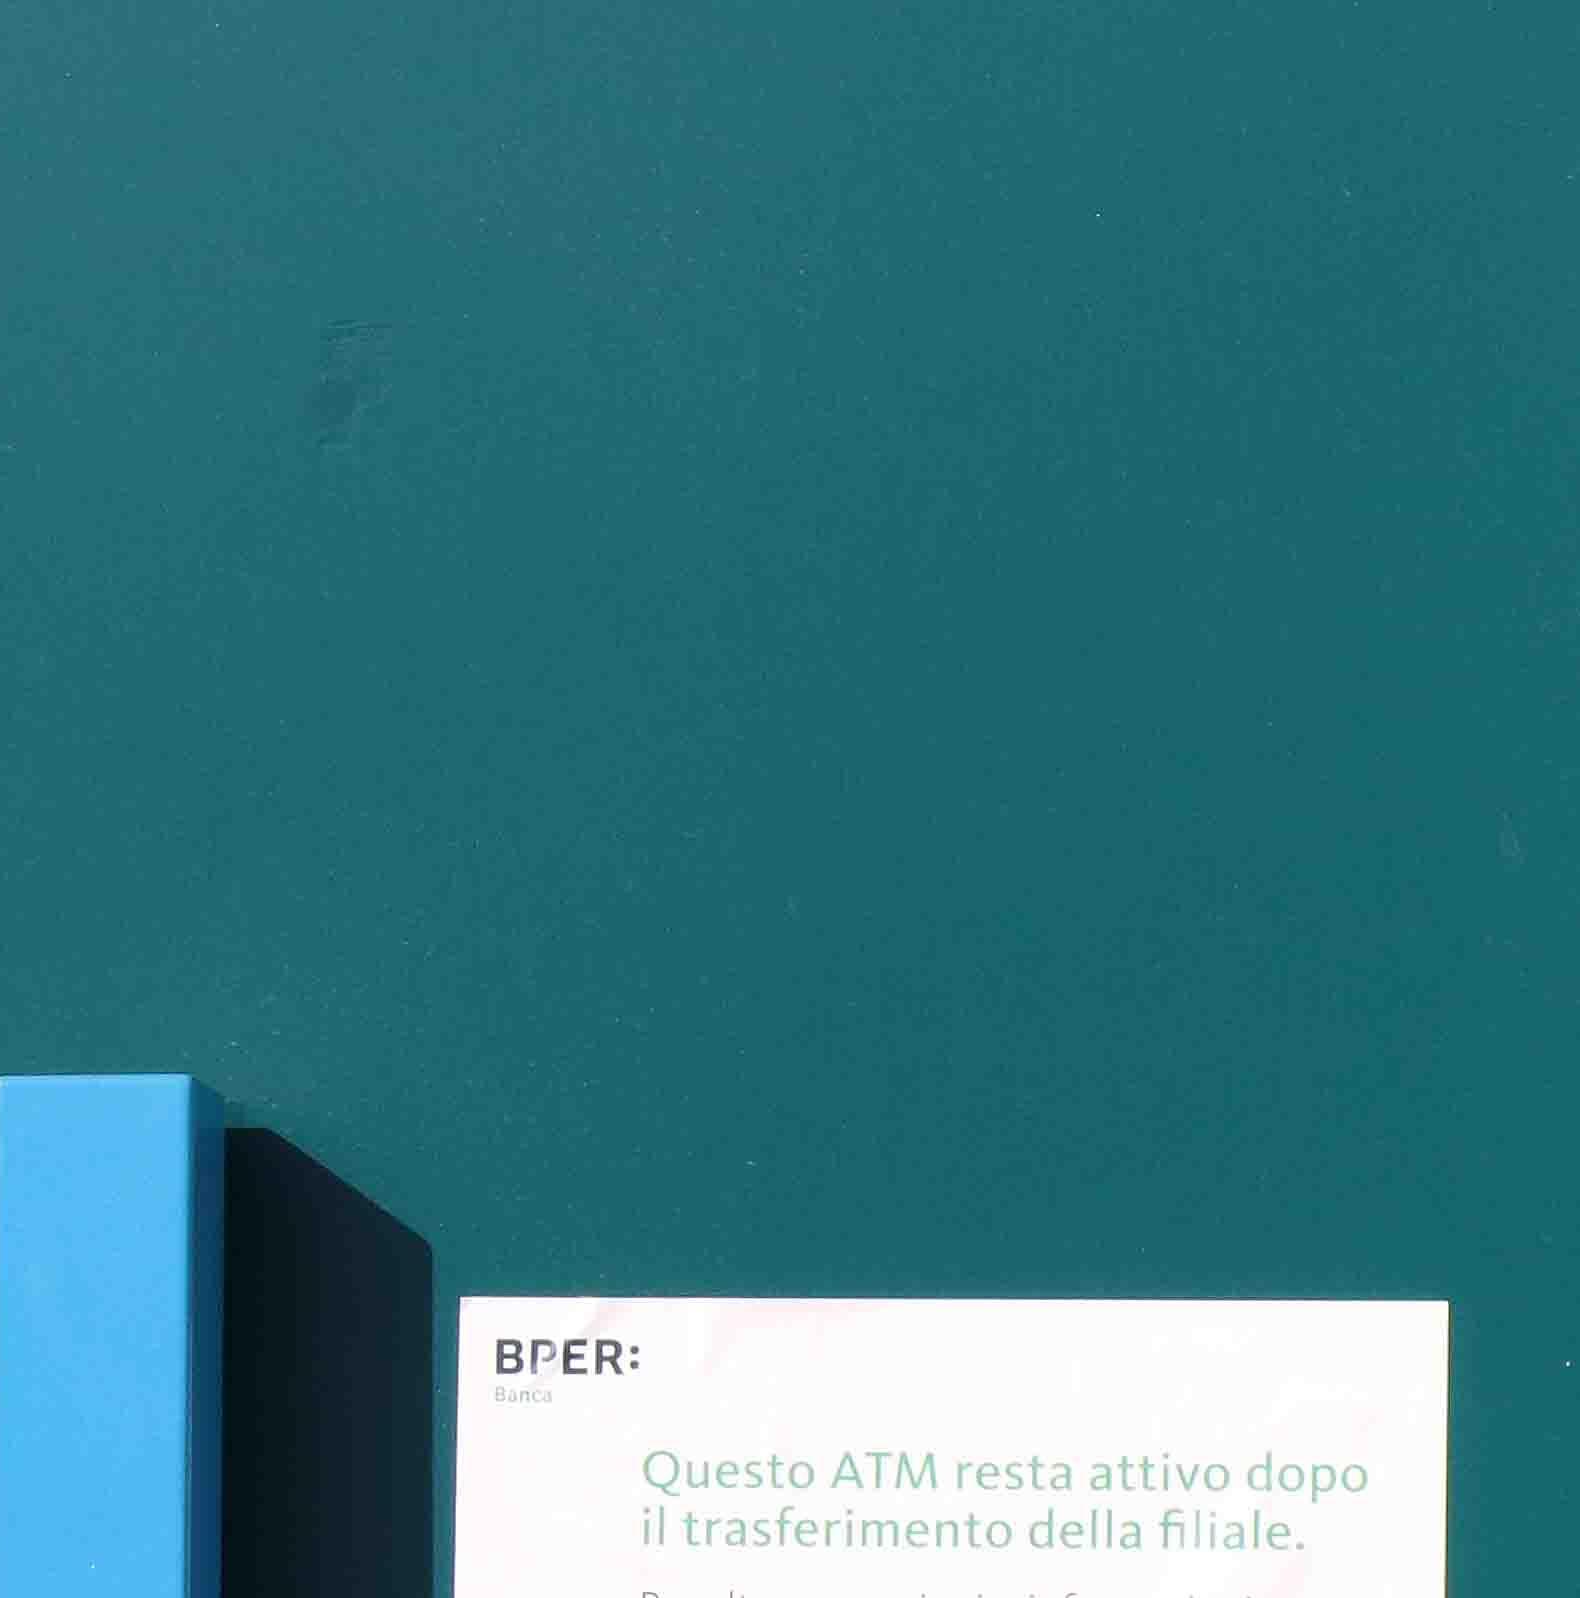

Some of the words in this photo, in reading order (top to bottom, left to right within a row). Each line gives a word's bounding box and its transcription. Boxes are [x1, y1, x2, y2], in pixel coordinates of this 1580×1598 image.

[496, 1386, 552, 1403] Banca
[643, 1450, 814, 1496] Questo
[830, 1452, 937, 1488] ATM
[957, 1456, 1072, 1491] resta
[1090, 1453, 1230, 1491] attivo
[1248, 1451, 1368, 1504] dopo
[643, 1506, 664, 1545] il
[682, 1506, 1012, 1548] trasferimento
[1029, 1508, 1141, 1549] della
[1159, 1508, 1304, 1550] filiale.
